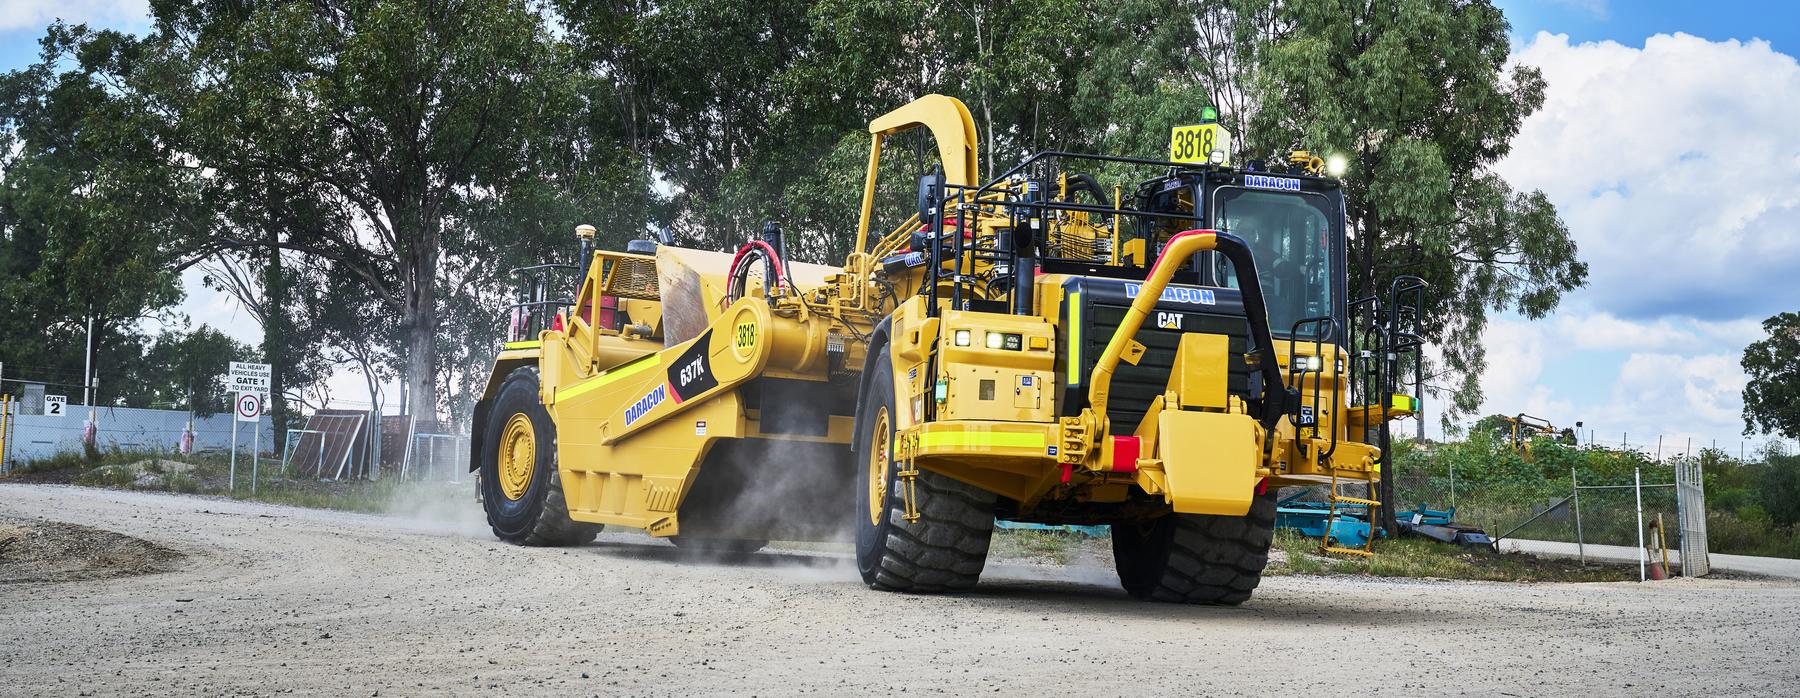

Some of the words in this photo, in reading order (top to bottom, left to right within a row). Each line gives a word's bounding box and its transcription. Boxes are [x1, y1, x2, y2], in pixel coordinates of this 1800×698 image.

[1174, 128, 1213, 159] 3818
[1245, 175, 1300, 190] DARACON
[1125, 283, 1215, 305] DACON
[1157, 312, 1183, 329] CAT
[738, 323, 755, 347] 3818
[680, 355, 704, 387] 637K
[236, 377, 258, 385] GATE
[51, 403, 60, 414] 2
[244, 401, 254, 411] 10
[625, 384, 665, 426] DARACON
